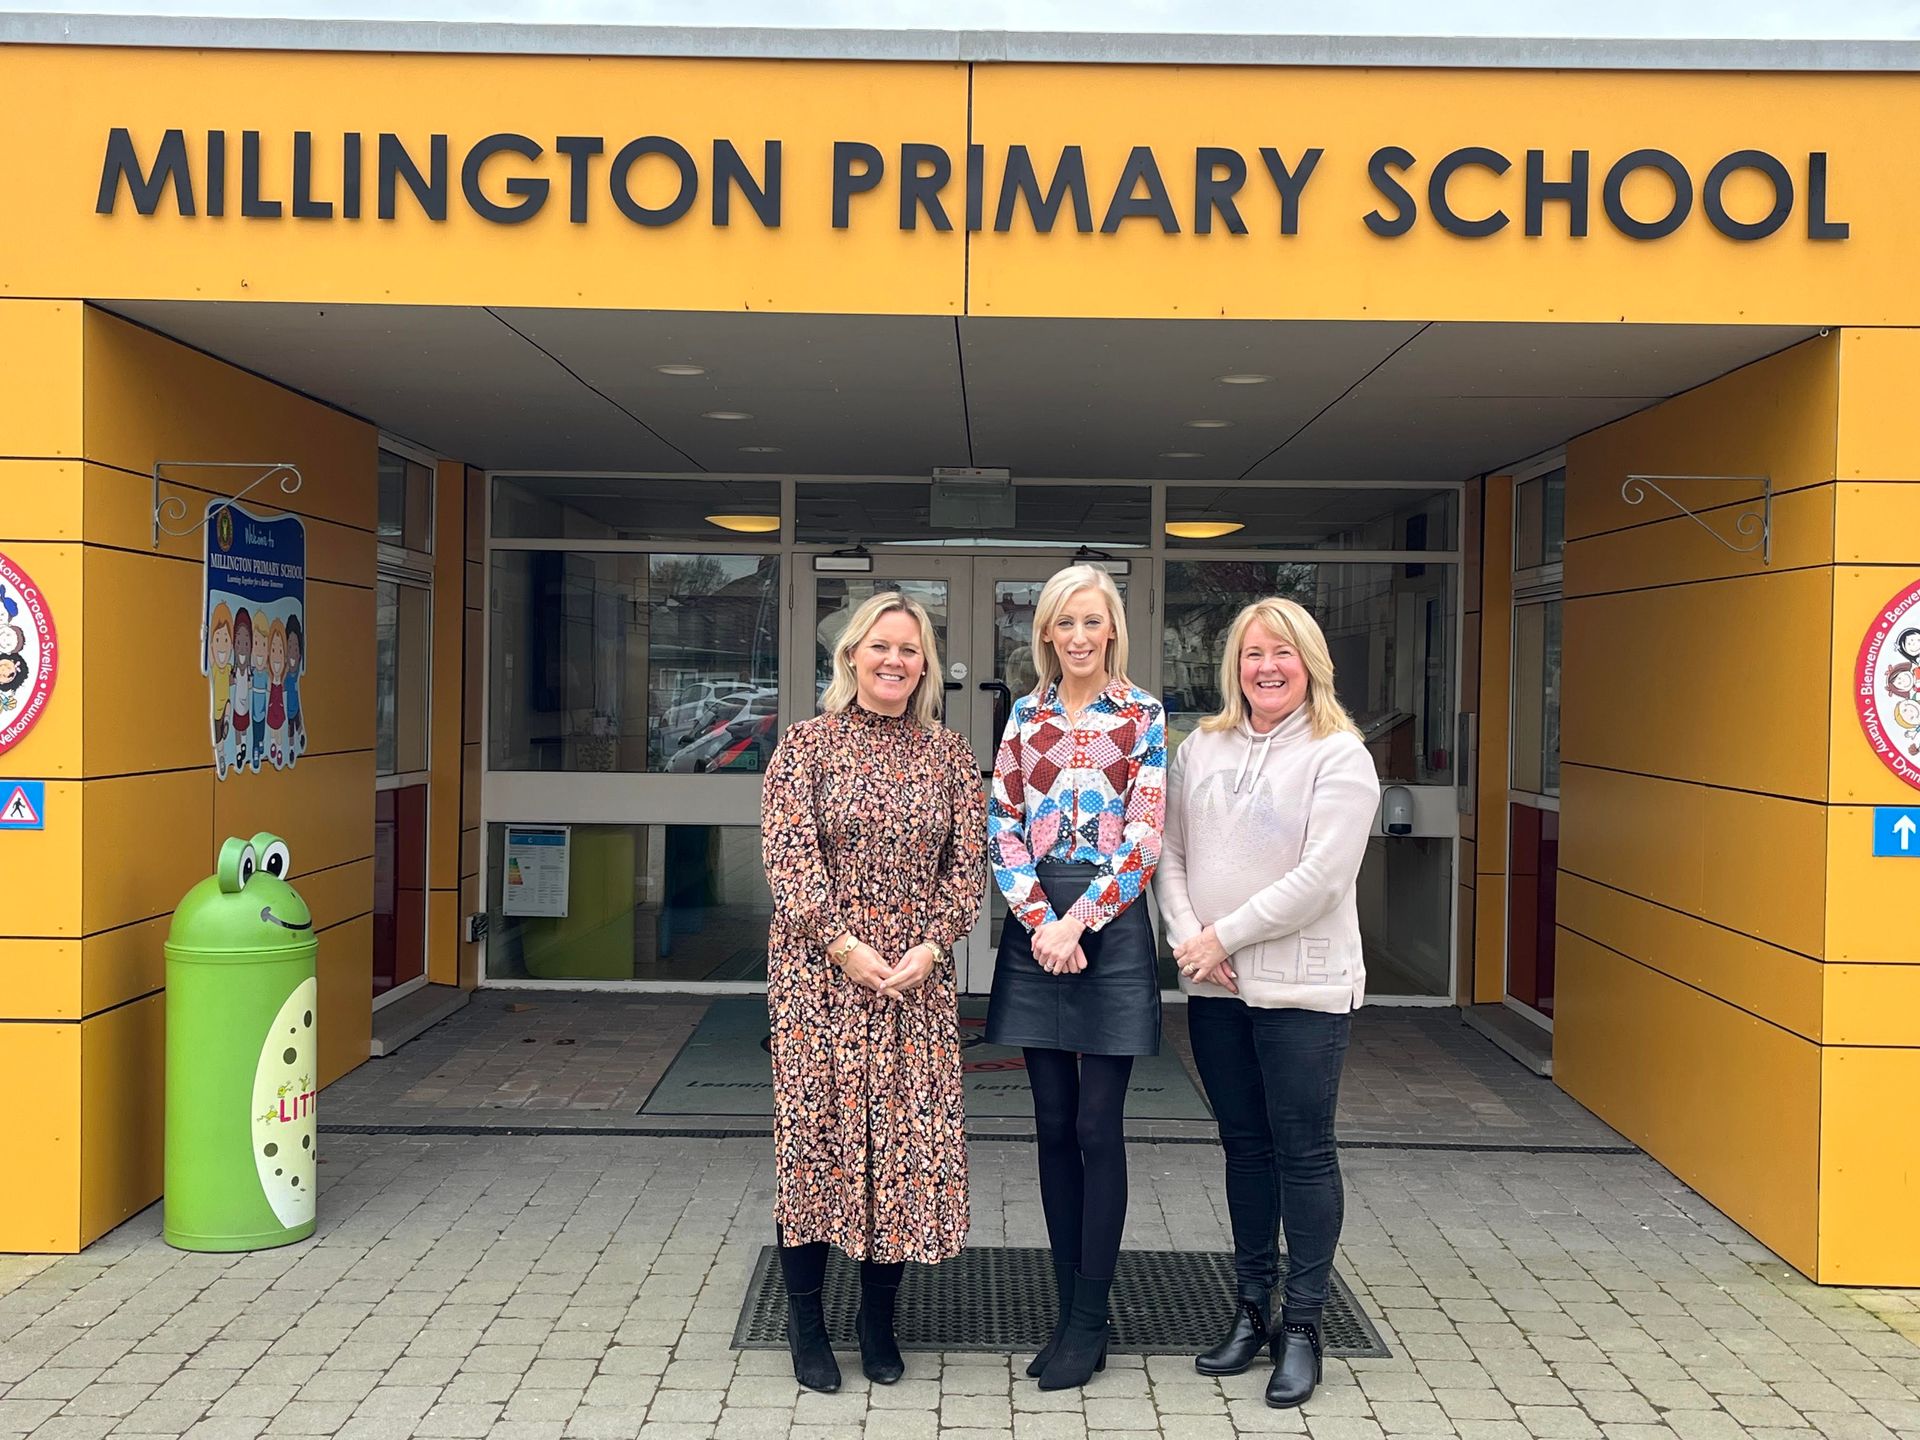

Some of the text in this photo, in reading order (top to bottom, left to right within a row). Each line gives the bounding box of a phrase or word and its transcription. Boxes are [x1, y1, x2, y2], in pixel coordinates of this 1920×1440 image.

[95, 127, 1850, 241] MILLINGTON PRIMARY SCHOOL
[210, 552, 304, 580] MILLINGTON PRIMARY SCHOOL
[0, 557, 21, 585] kom
[24, 588, 48, 634] Croeso
[1860, 631, 1885, 695] Bienvenue
[0, 691, 46, 746] Velkommen
[1863, 707, 1889, 753] Witamy
[1892, 756, 1920, 784] Dynn
[280, 1090, 316, 1123] LITT
[686, 1080, 774, 1088] Learnin
